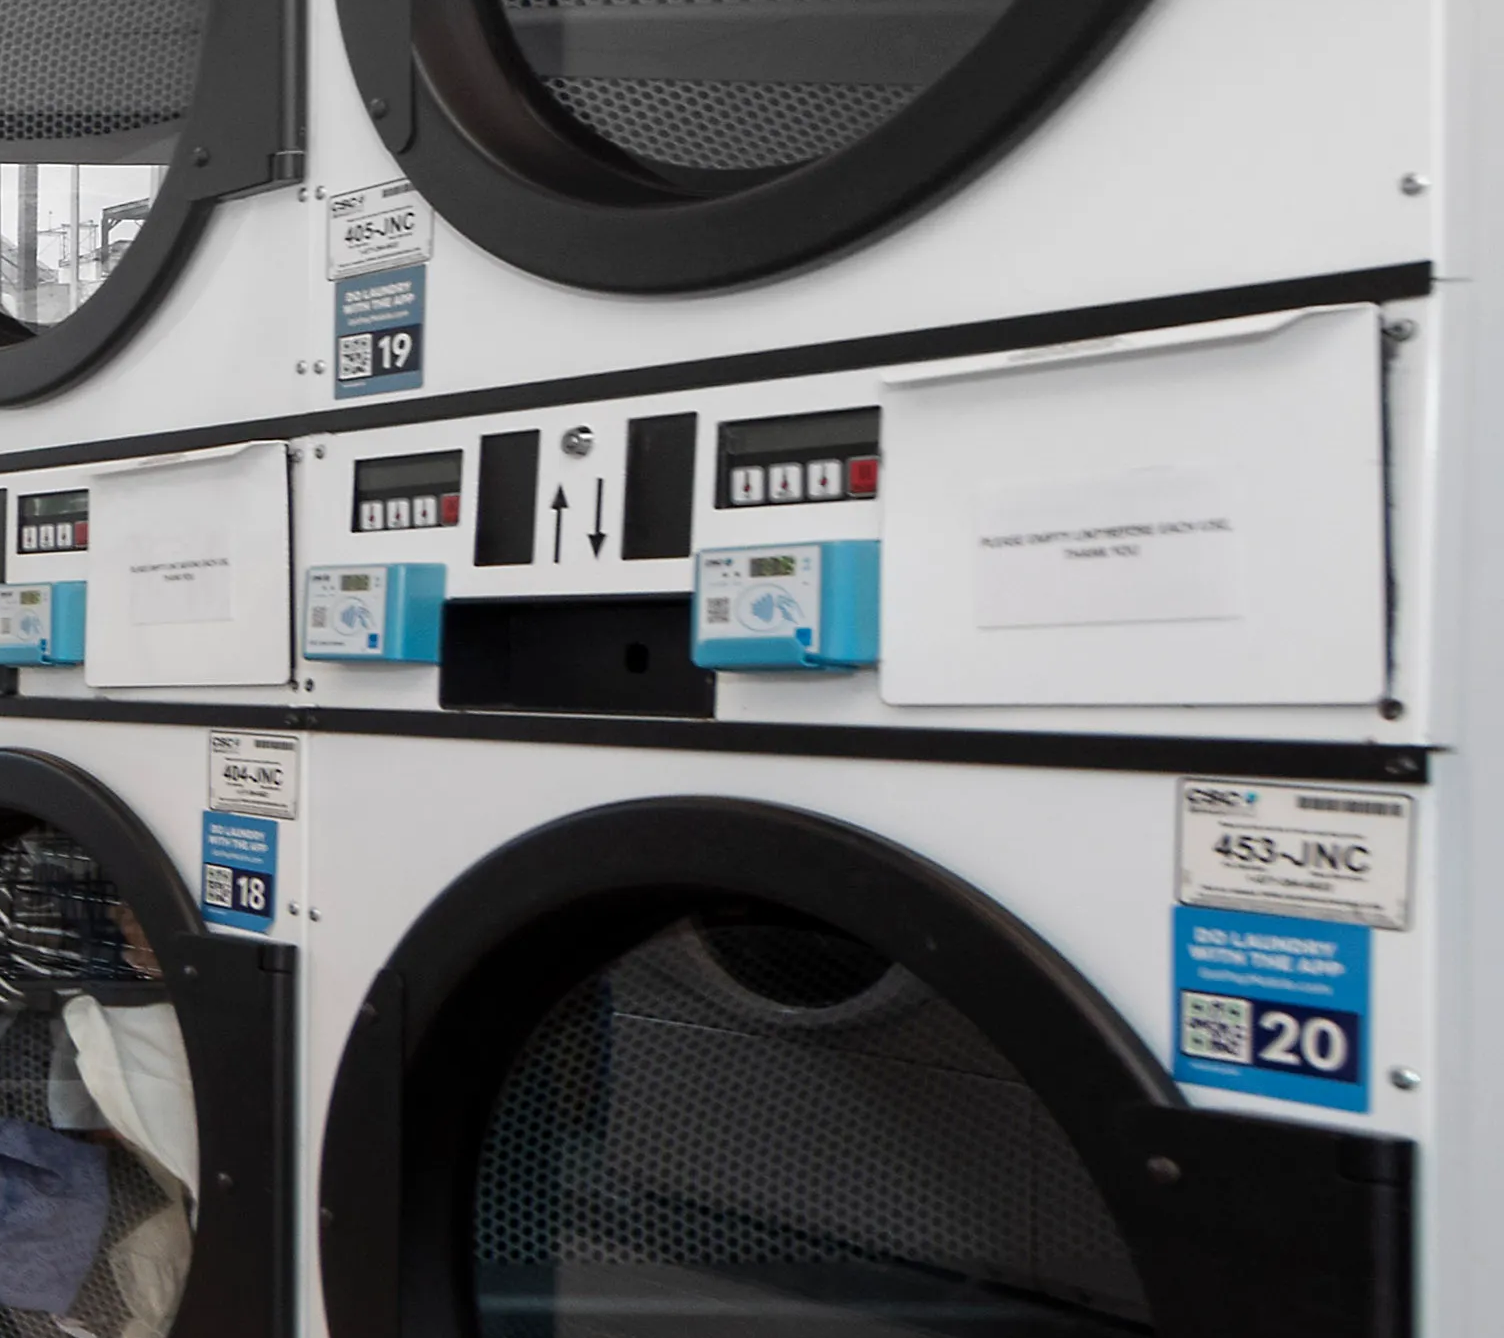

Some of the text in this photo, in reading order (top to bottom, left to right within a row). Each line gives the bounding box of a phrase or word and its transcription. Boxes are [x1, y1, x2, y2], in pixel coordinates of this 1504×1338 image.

[343, 212, 415, 243] 405-JNC
[377, 332, 413, 369] 19
[1213, 834, 1371, 873] 453-JNC
[237, 875, 265, 910] 18
[1257, 1010, 1348, 1072] 20
